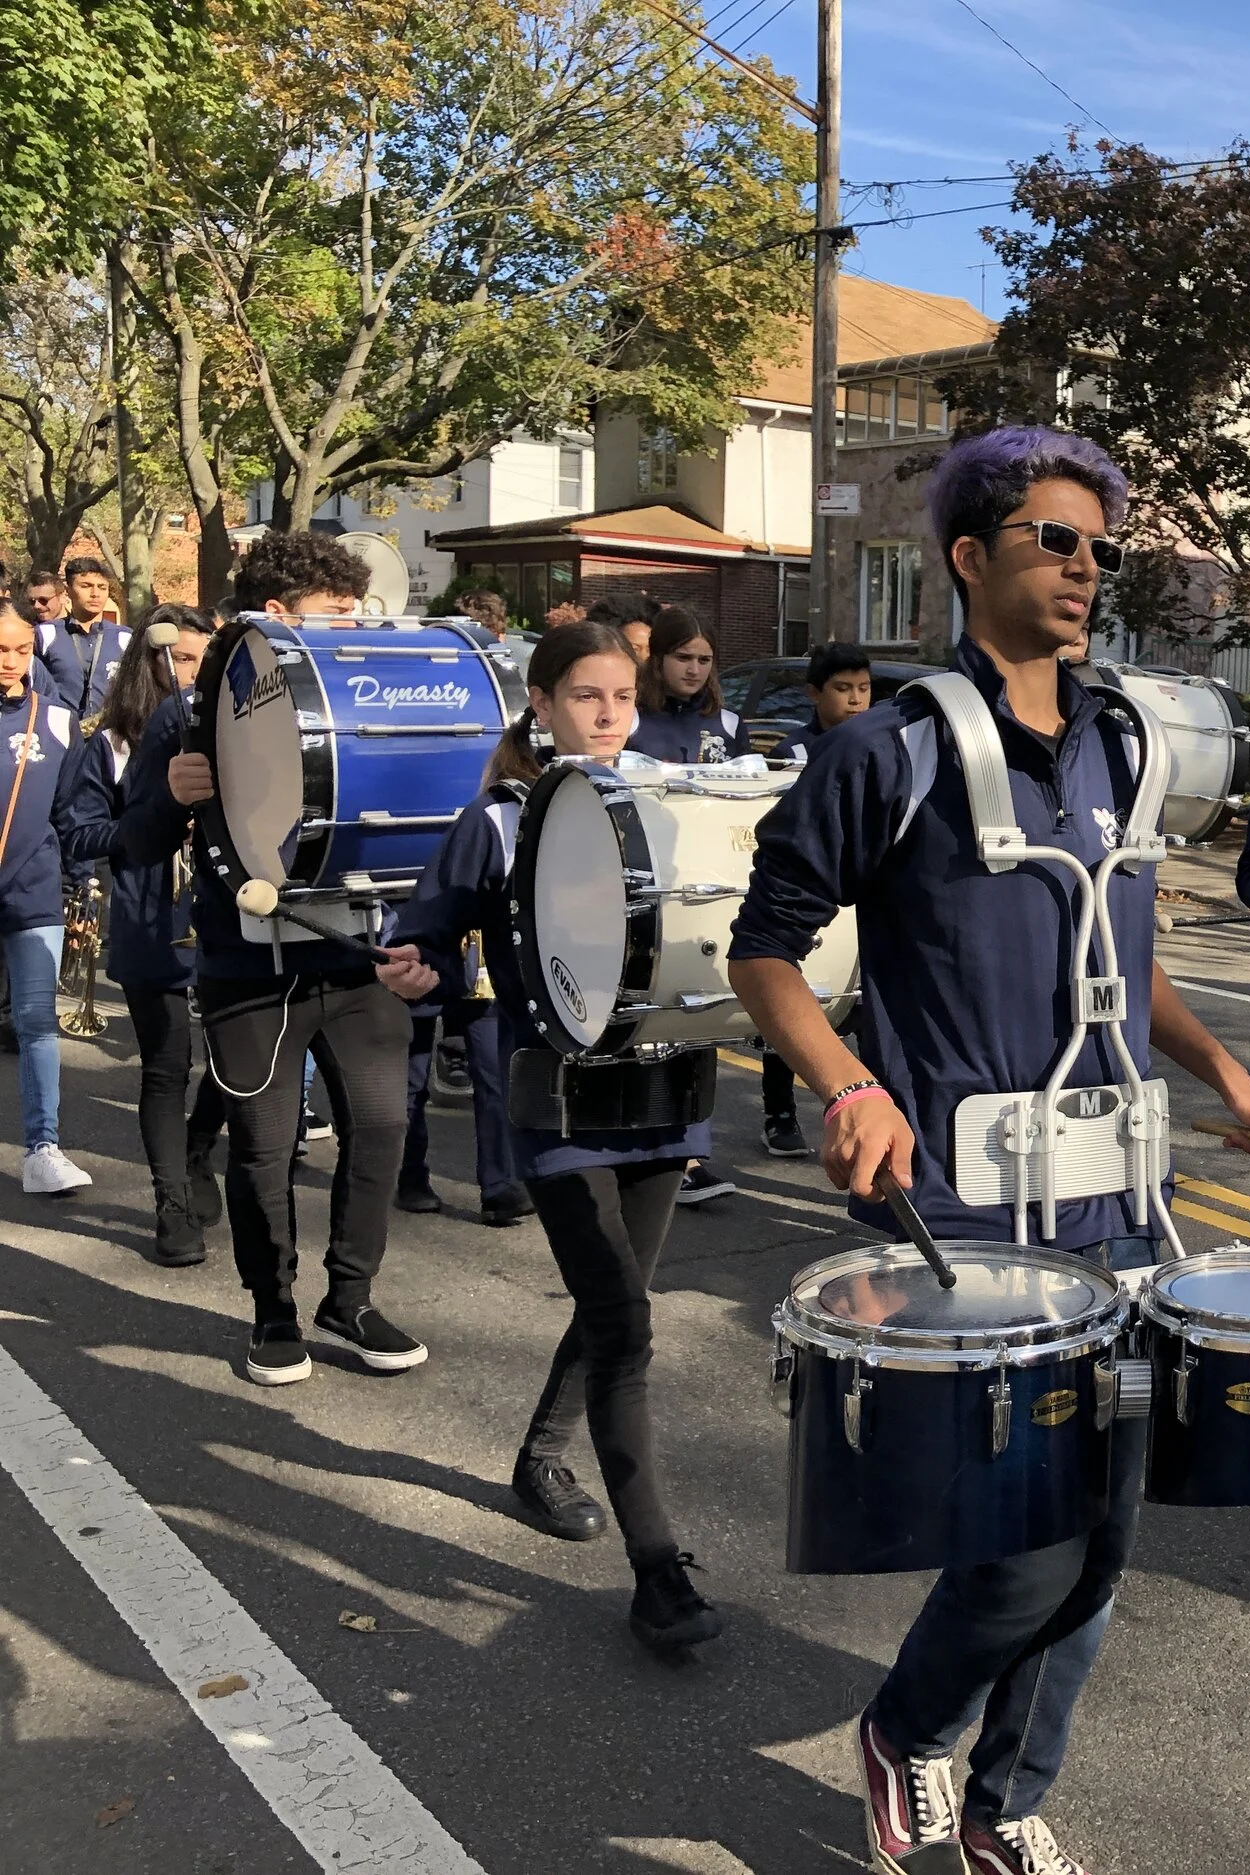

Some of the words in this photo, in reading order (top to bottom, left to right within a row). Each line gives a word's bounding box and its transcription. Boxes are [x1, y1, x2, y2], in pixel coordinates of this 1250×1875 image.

[347, 675, 470, 710] Dynasty
[554, 962, 583, 1015] EVANS
[1092, 985, 1114, 1011] M
[1079, 1090, 1102, 1116] M
